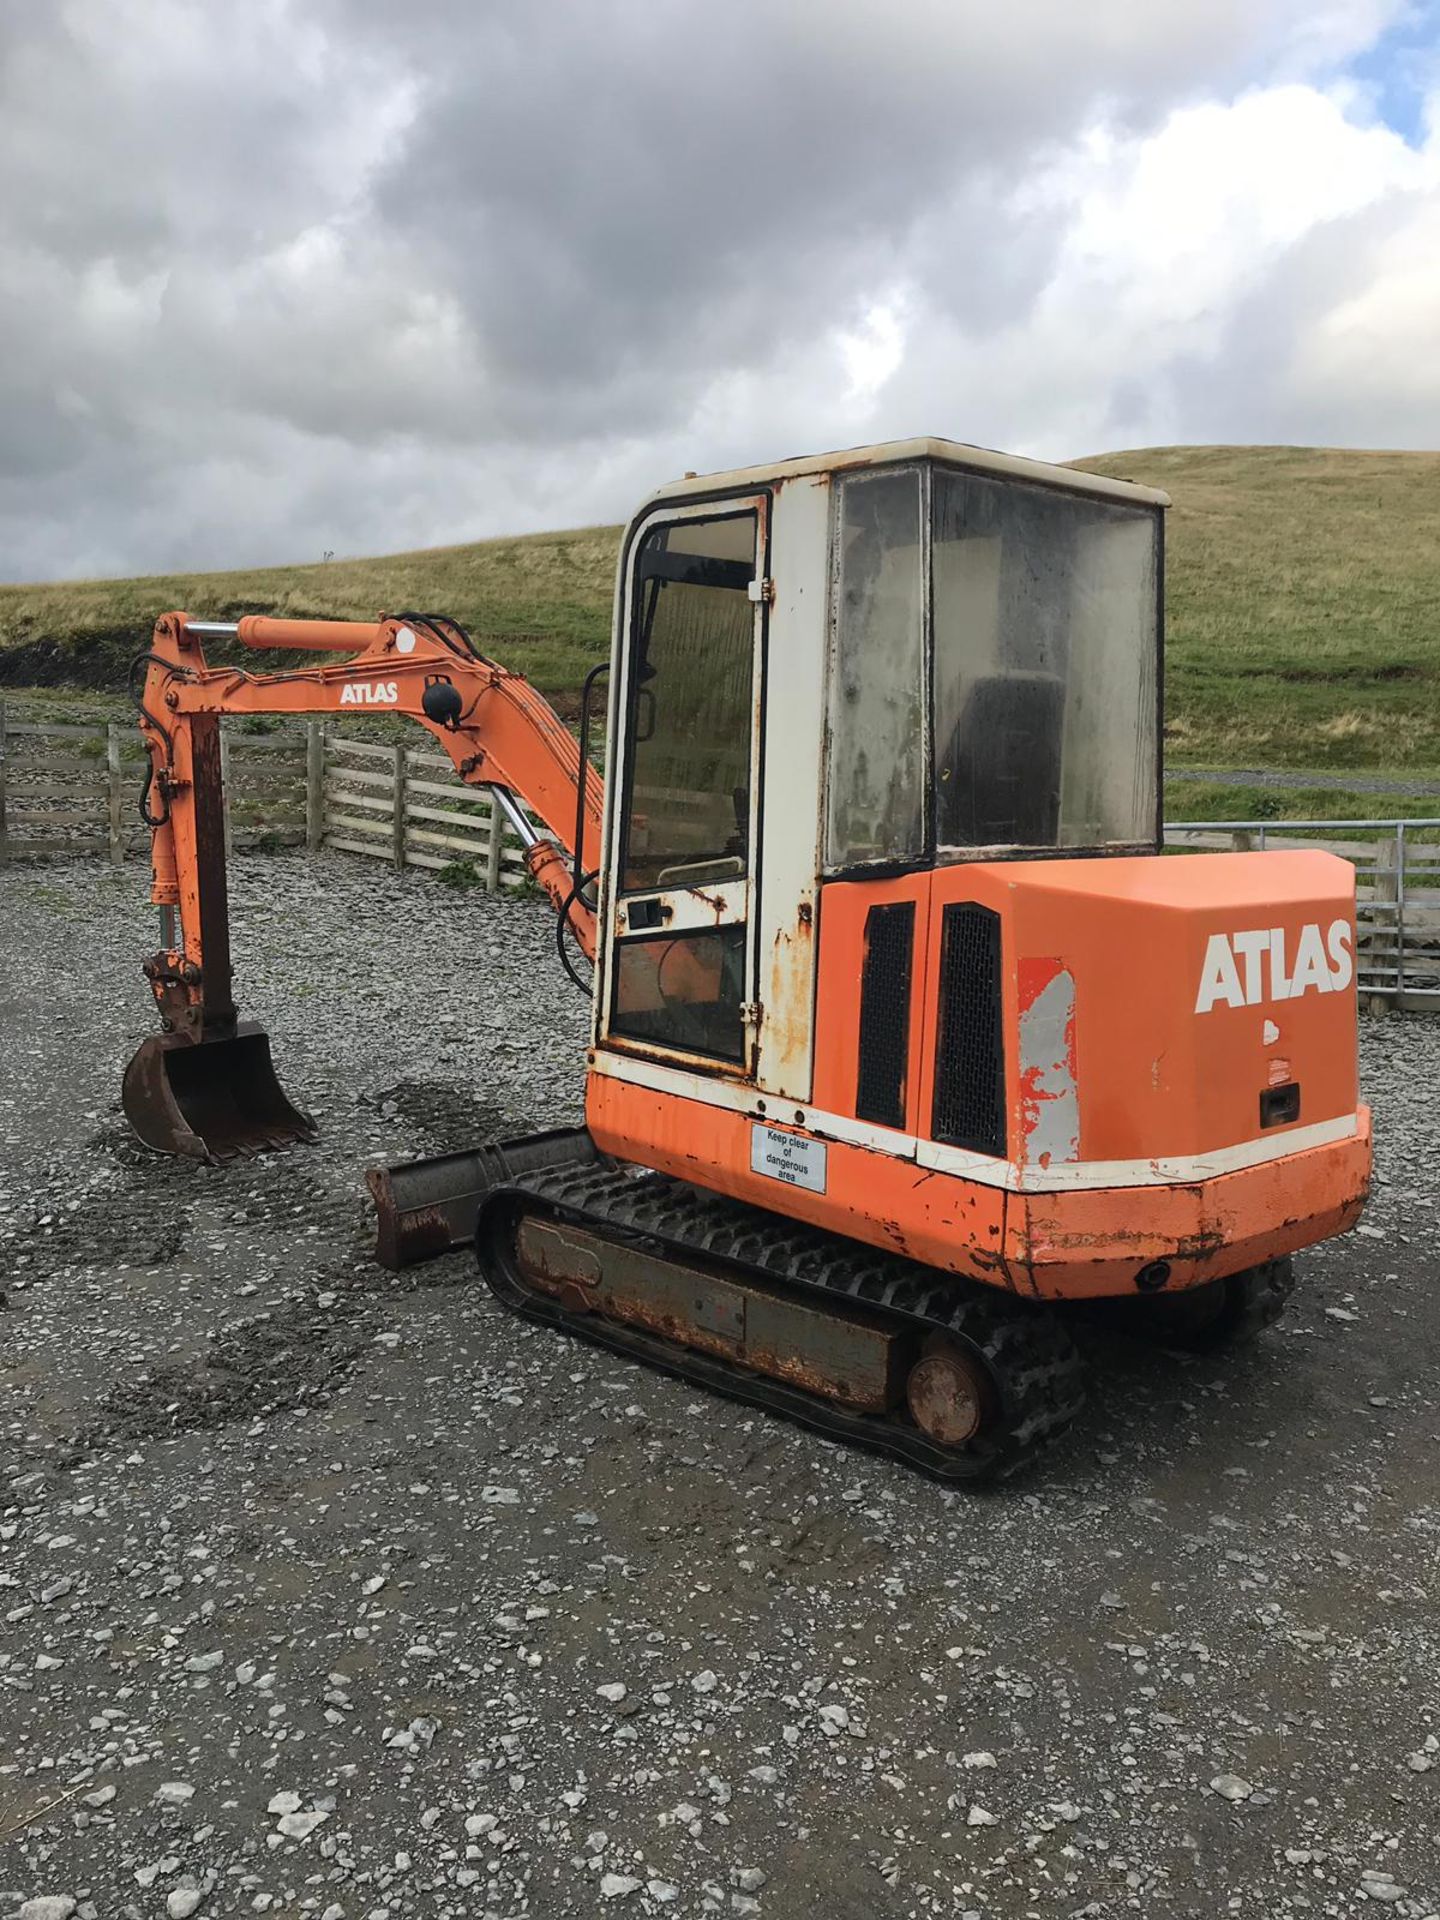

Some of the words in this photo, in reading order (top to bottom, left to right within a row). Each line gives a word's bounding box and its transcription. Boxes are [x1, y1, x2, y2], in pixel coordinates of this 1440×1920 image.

[340, 682, 398, 704] ATLAS
[1194, 919, 1353, 1014] ATLAS
[767, 1129, 787, 1145] Keep
[789, 1137, 809, 1150] clear
[783, 1147, 792, 1157] of
[766, 1153, 808, 1174] dangerous
[778, 1170, 796, 1181] area
